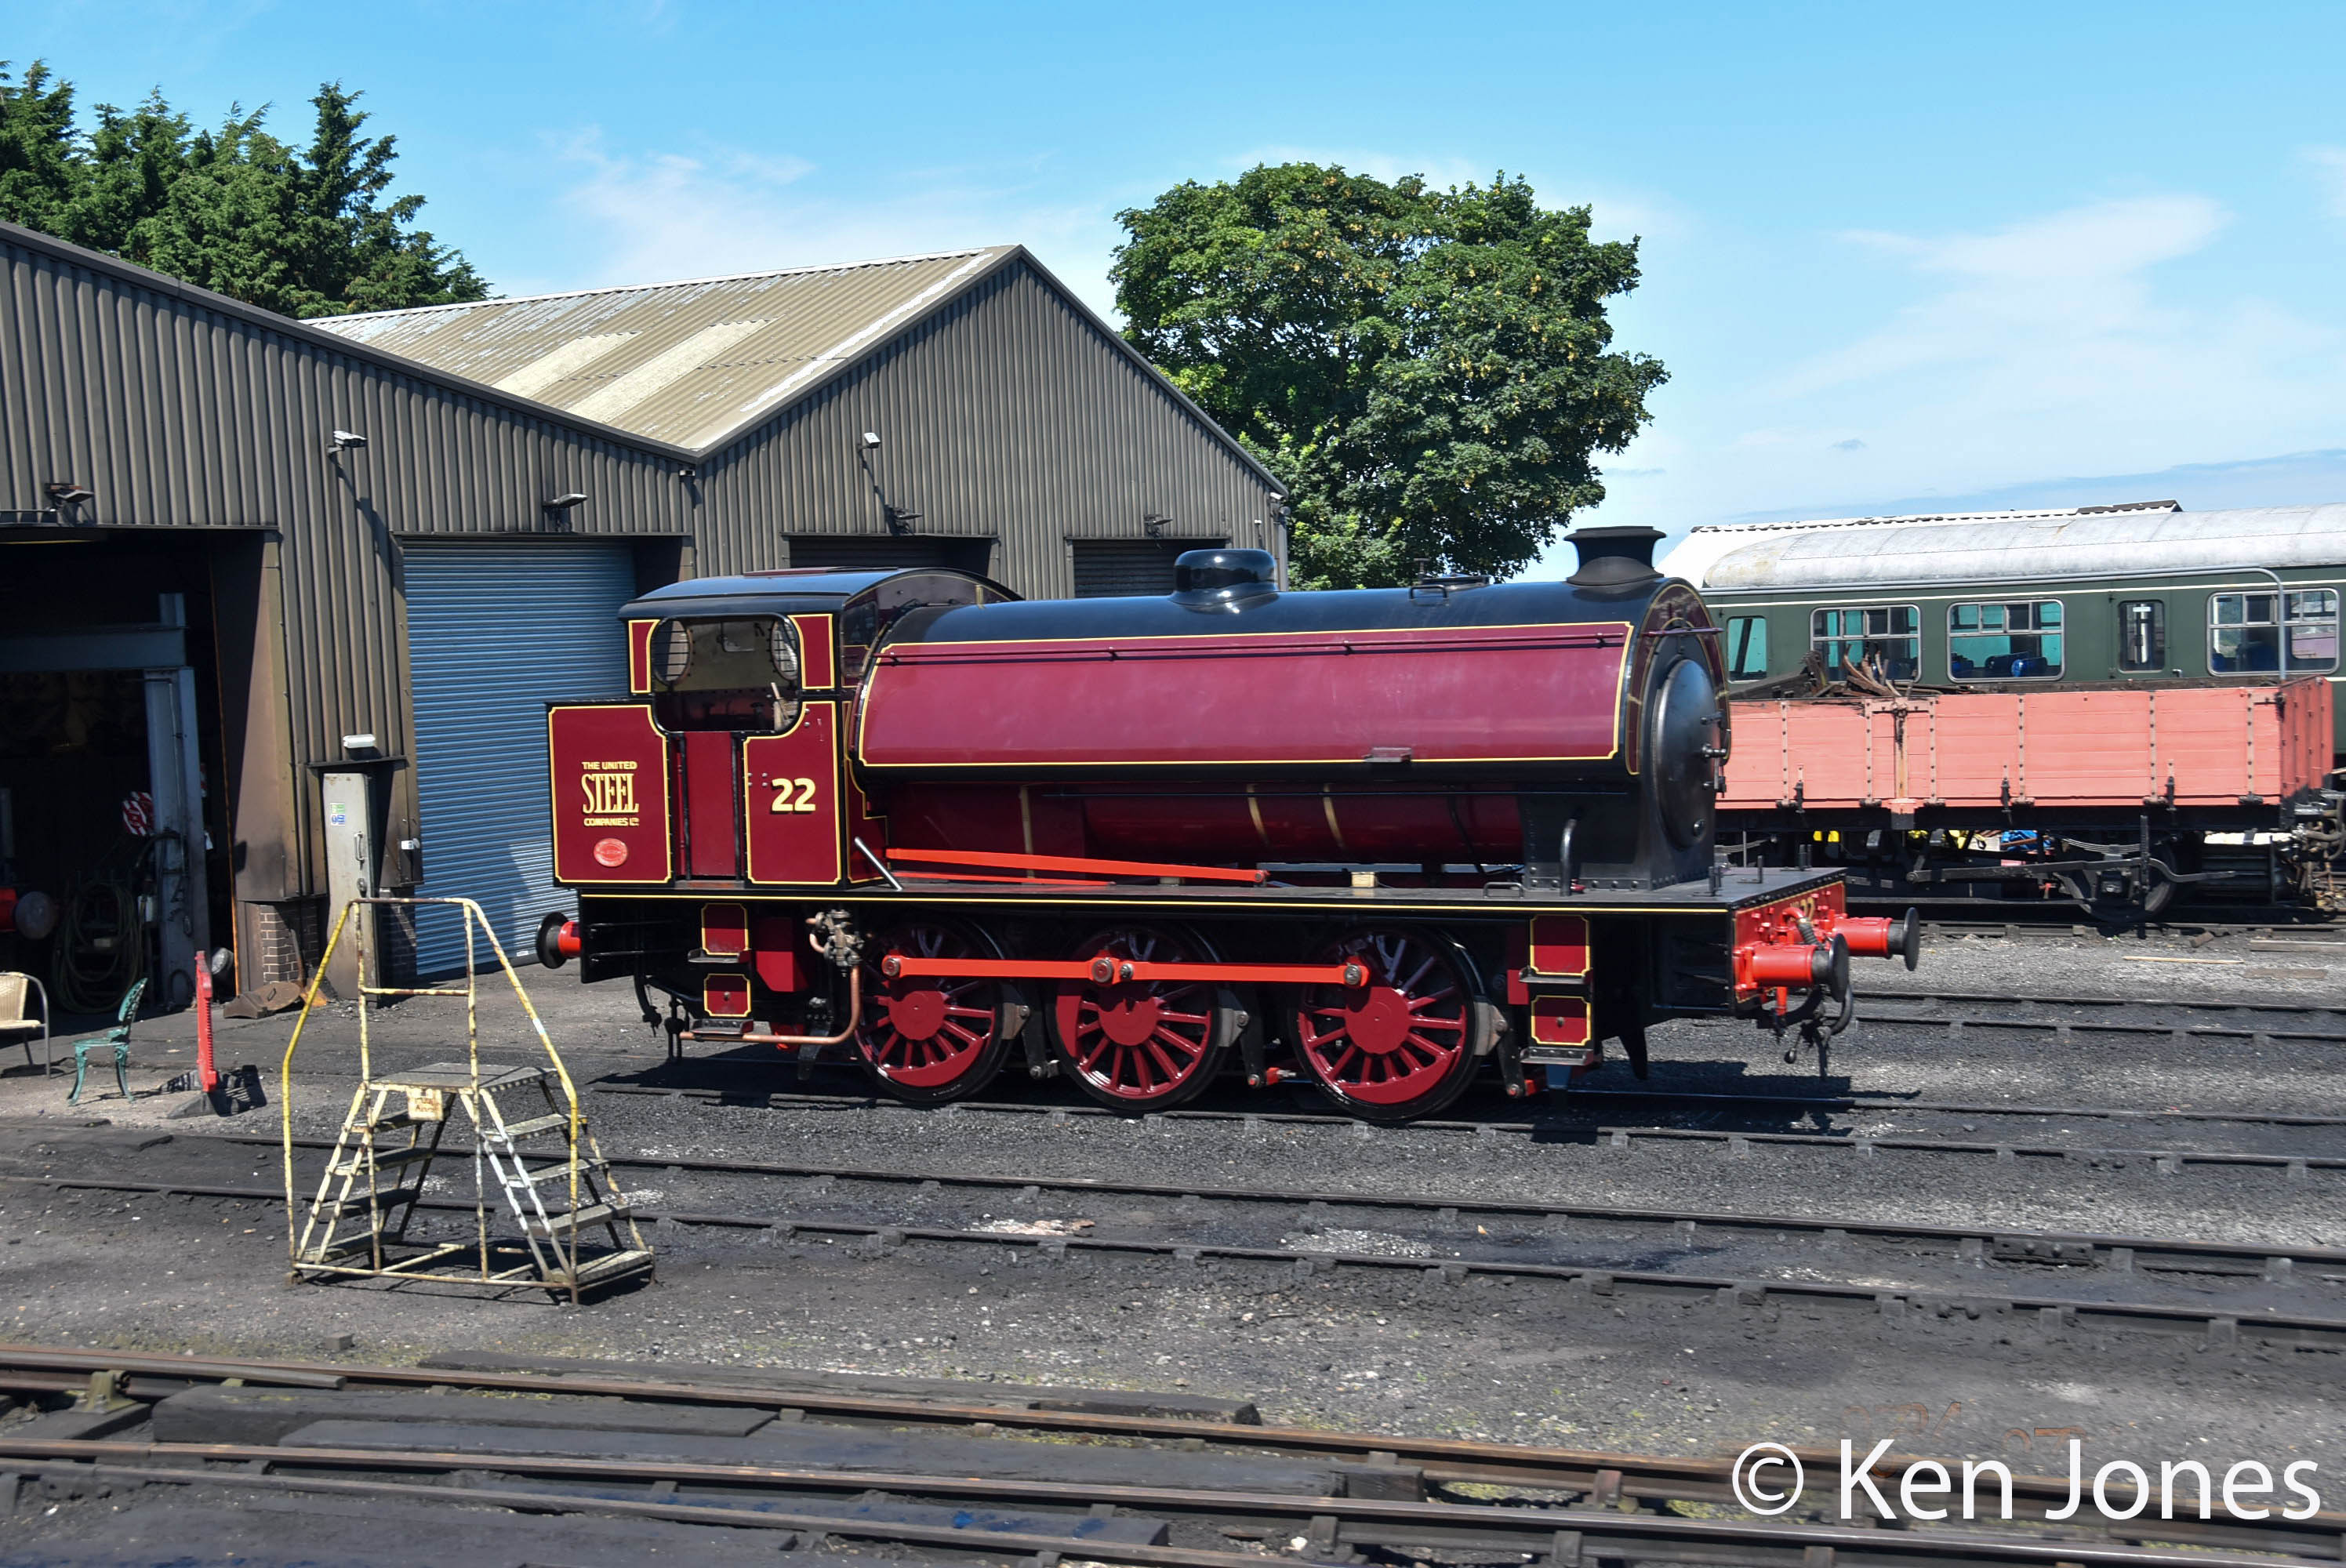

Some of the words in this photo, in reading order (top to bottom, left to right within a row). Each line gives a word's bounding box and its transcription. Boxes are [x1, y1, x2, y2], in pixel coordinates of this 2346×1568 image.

[581, 761, 601, 770] THE
[601, 760, 637, 770] UNITED
[581, 773, 640, 814] STEEL
[772, 778, 816, 811] 22
[583, 818, 628, 826] COMPANIES
